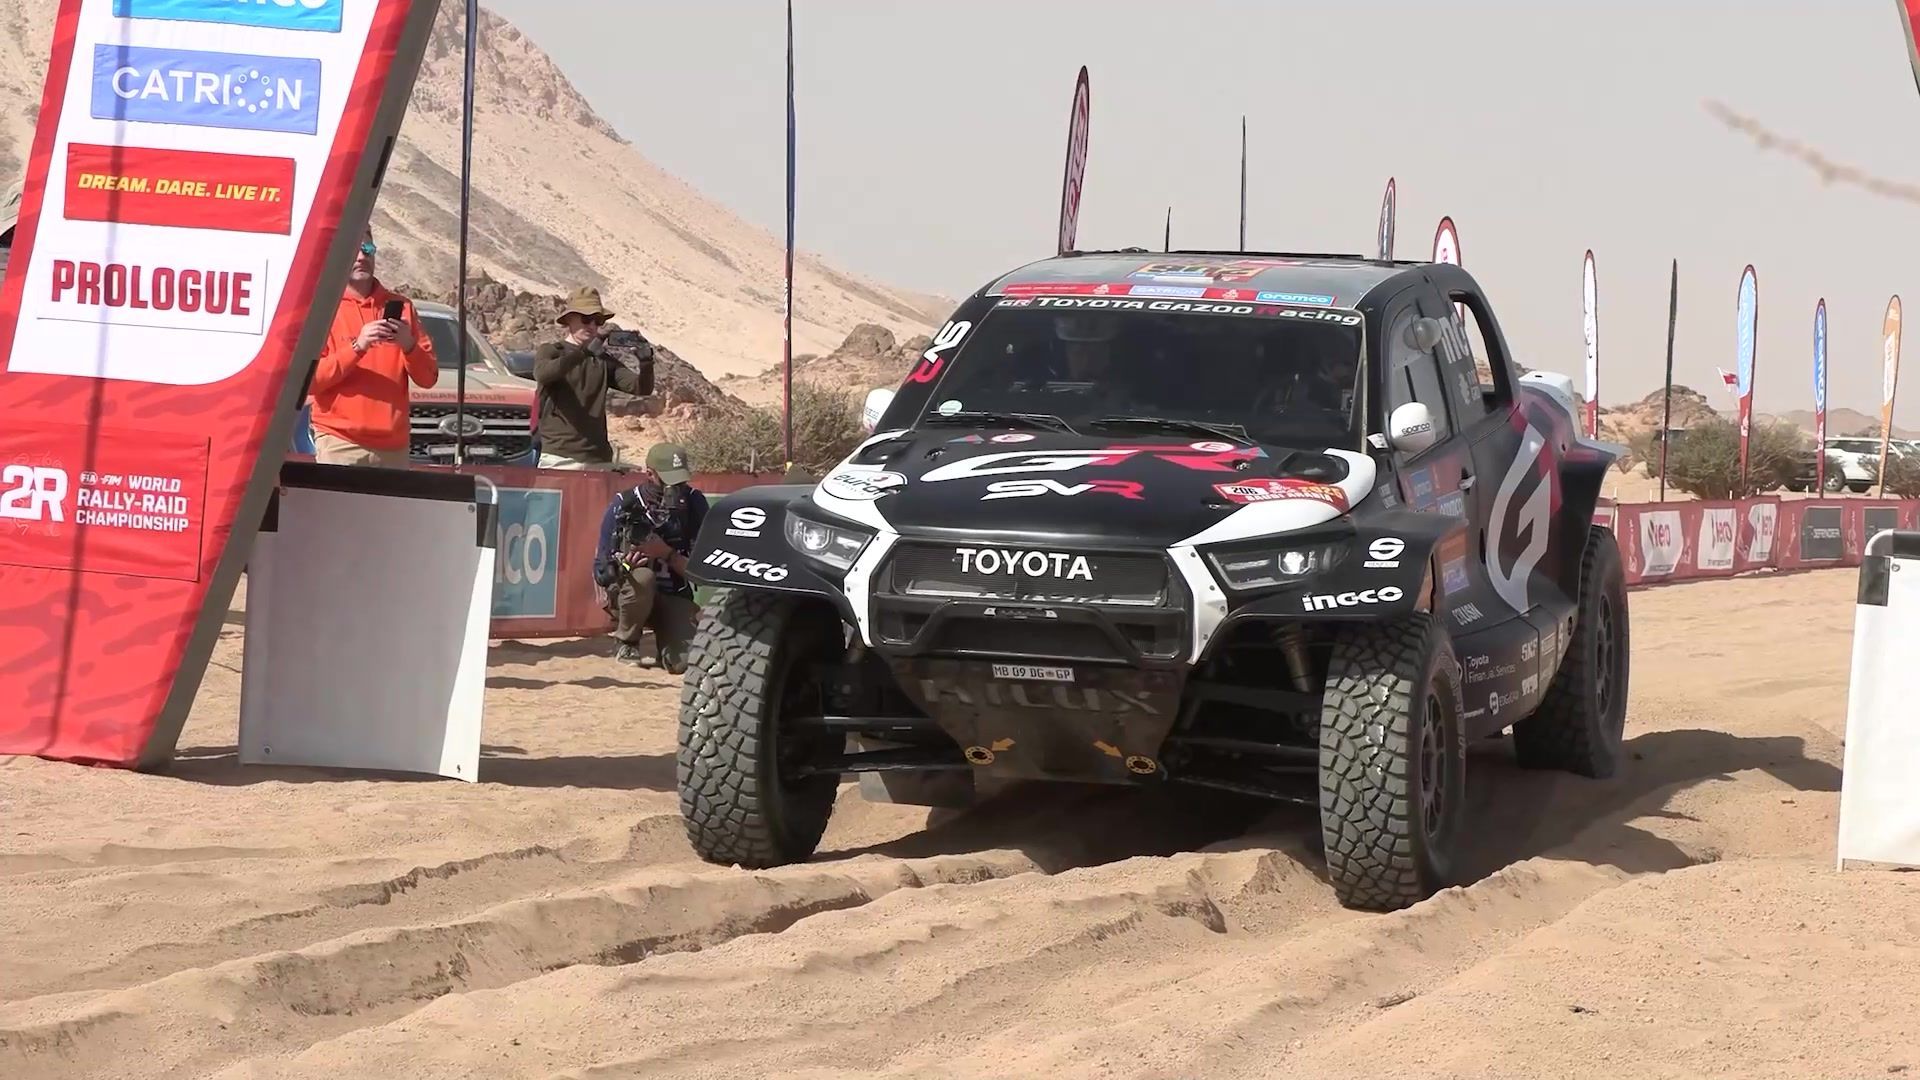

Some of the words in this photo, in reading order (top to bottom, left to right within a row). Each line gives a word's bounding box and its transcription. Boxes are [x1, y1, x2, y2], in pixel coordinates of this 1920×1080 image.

[111, 66, 302, 112] CATRION
[77, 172, 151, 195] DREAM.
[154, 178, 210, 199] DARE.
[214, 182, 258, 202] LIVE
[259, 185, 281, 203] IT.
[51, 258, 253, 316] PROLOGUE
[1262, 291, 1329, 304] aramco
[1036, 297, 1145, 311] TOYOTA
[1147, 301, 1254, 315] GAZOO
[1255, 306, 1363, 326] Racing
[1401, 422, 1431, 435] sparco
[128, 475, 182, 493] WORLD
[1230, 486, 1260, 496] 206
[77, 487, 189, 515] RALLY-RAID
[75, 509, 190, 533] CHAMPIONSHIP
[955, 547, 1094, 581] TOYOTA
[994, 666, 1009, 677] MB
[1012, 666, 1026, 677] 09
[1029, 667, 1045, 678] DG
[1055, 669, 1071, 680] GP
